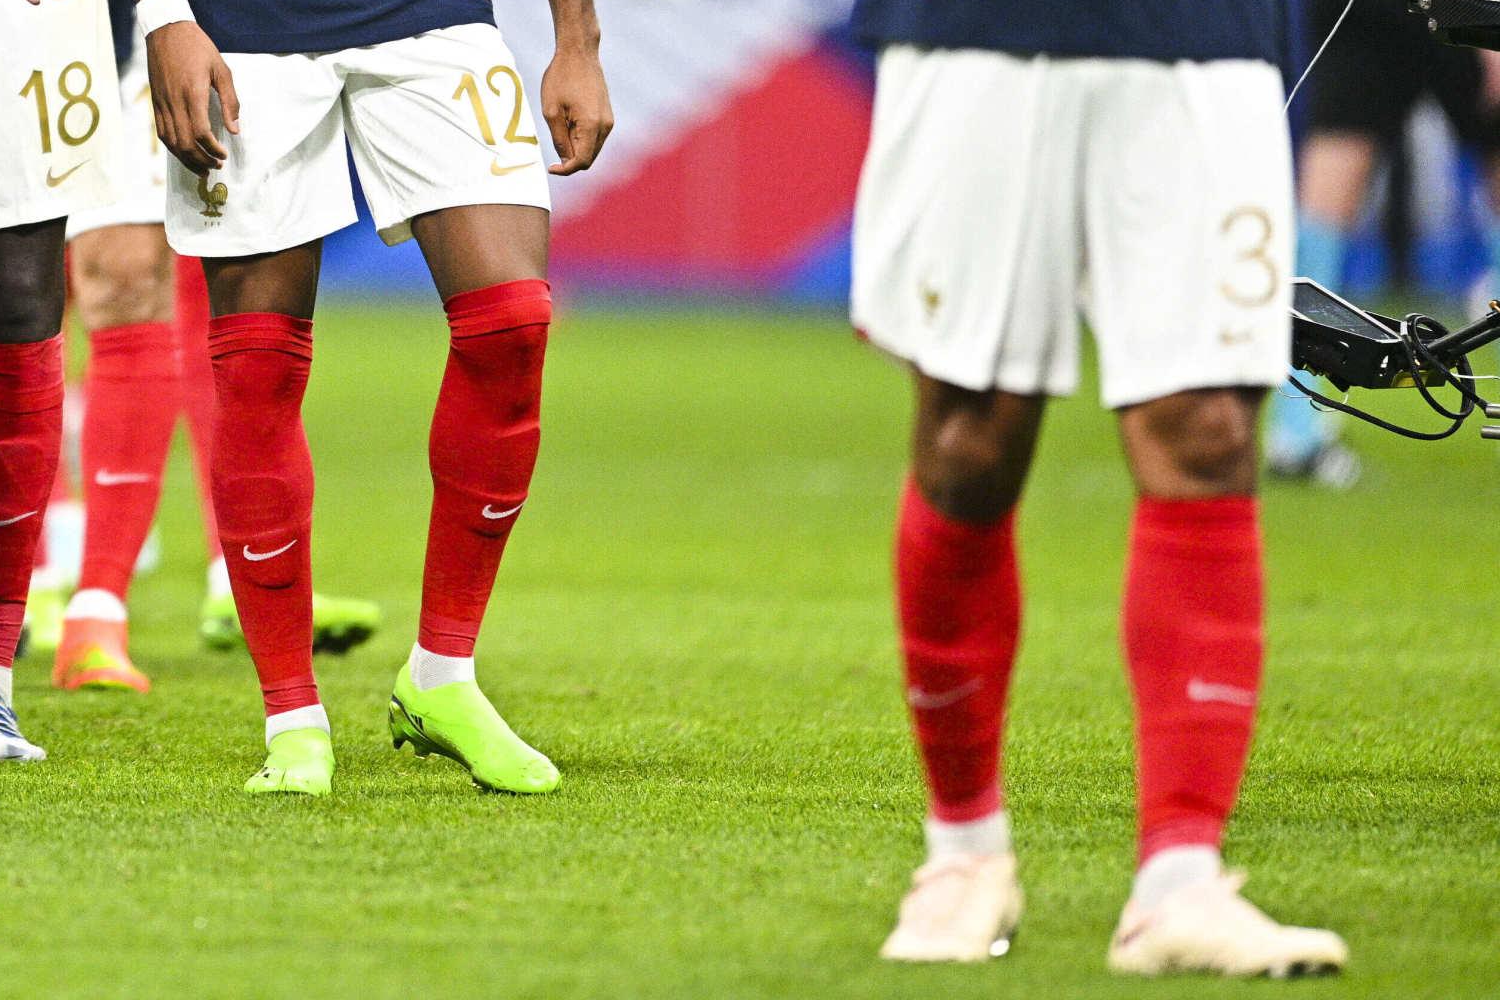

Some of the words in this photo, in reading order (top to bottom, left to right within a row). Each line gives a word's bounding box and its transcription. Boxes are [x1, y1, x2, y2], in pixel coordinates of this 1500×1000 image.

[18, 61, 100, 153] 18
[451, 65, 538, 145] 12
[1218, 204, 1281, 309] 3
